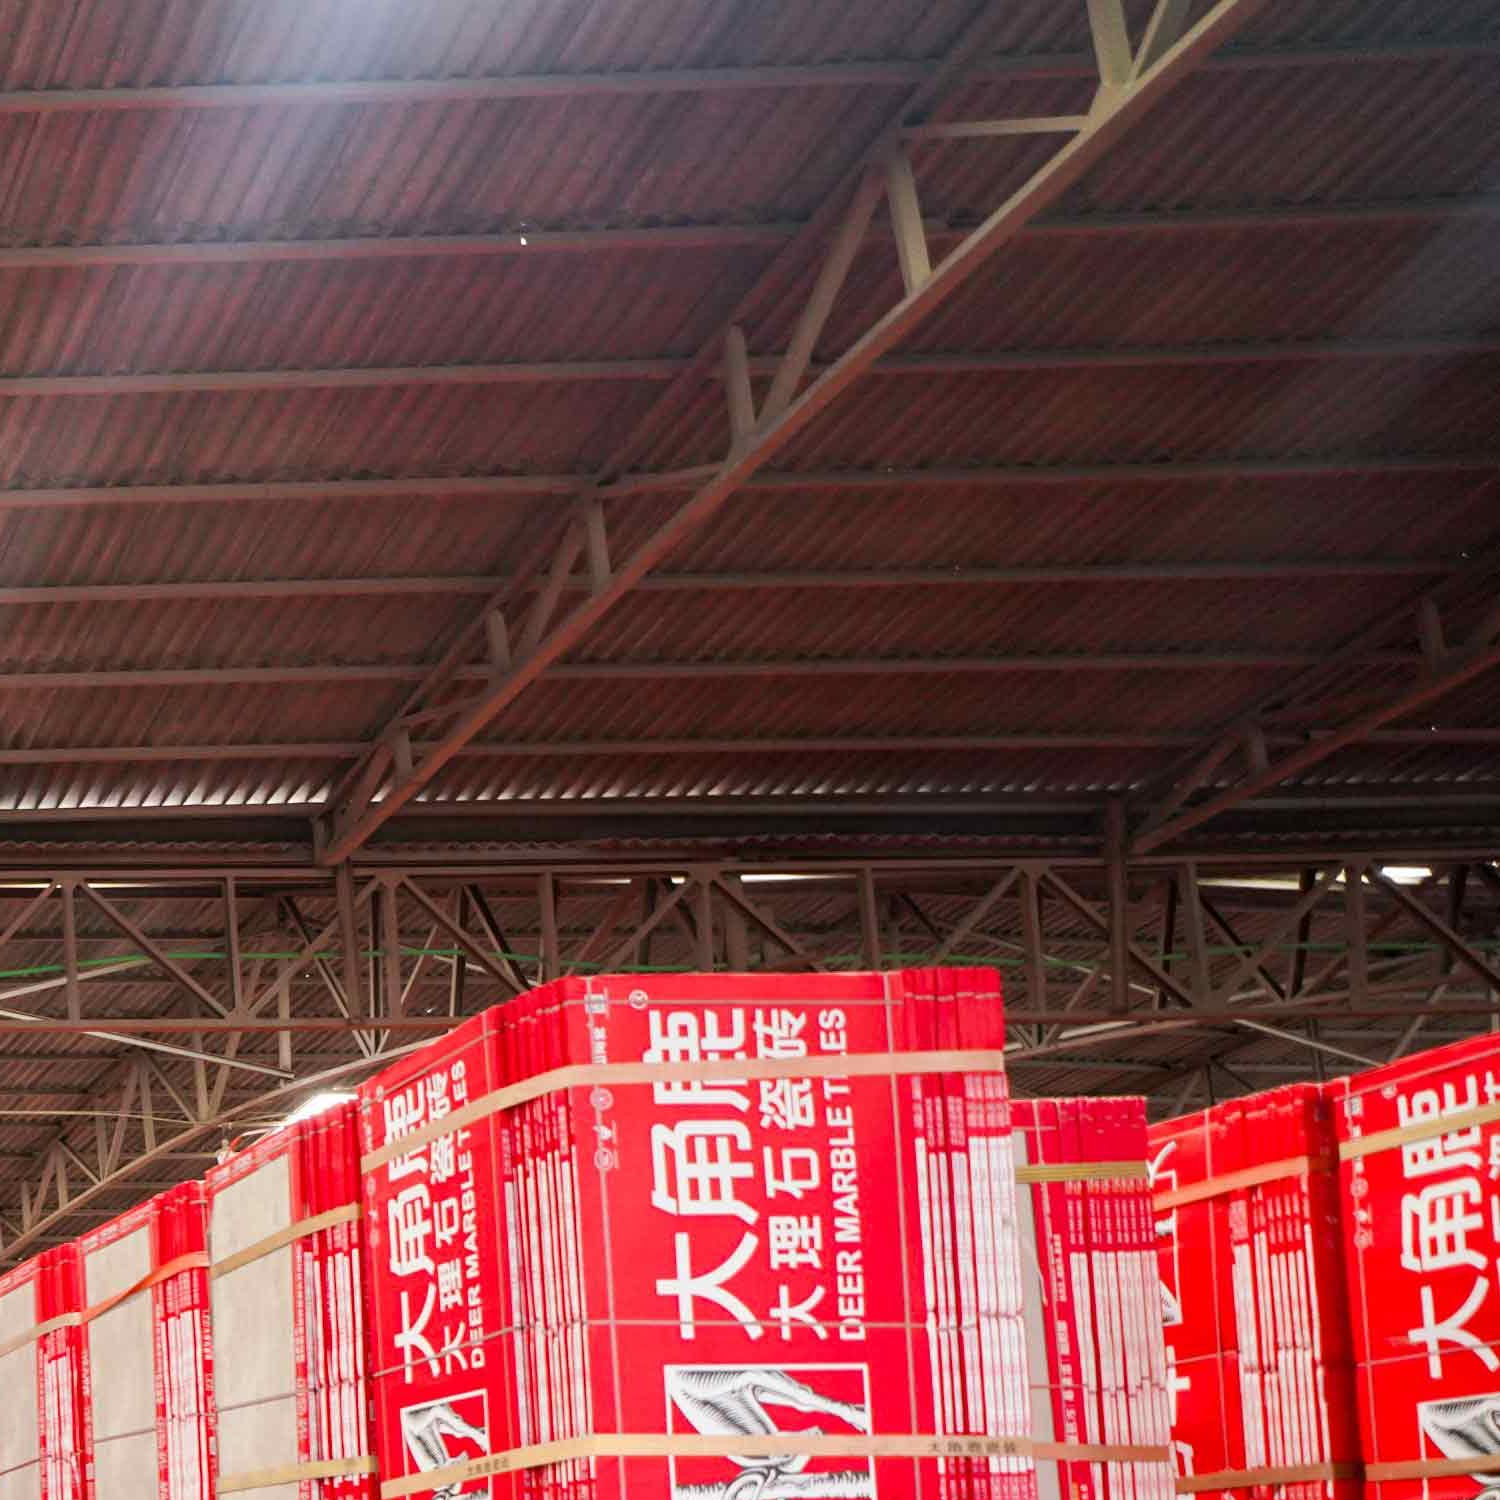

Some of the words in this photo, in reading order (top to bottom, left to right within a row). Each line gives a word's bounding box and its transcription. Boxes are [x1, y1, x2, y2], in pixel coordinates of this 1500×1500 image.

[451, 1060, 471, 1147] TES
[819, 1009, 851, 1099] TIES
[384, 1080, 440, 1384] 大角鹿
[458, 1151, 479, 1280] MARBLE
[643, 1009, 764, 1340] 大角鹿
[752, 1009, 829, 1340] 大理石瓷砖
[826, 1106, 861, 1243] MARBLE
[1396, 1074, 1499, 1379] 大角鹿
[468, 1285, 486, 1369] DEER
[836, 1249, 866, 1341] DEER
